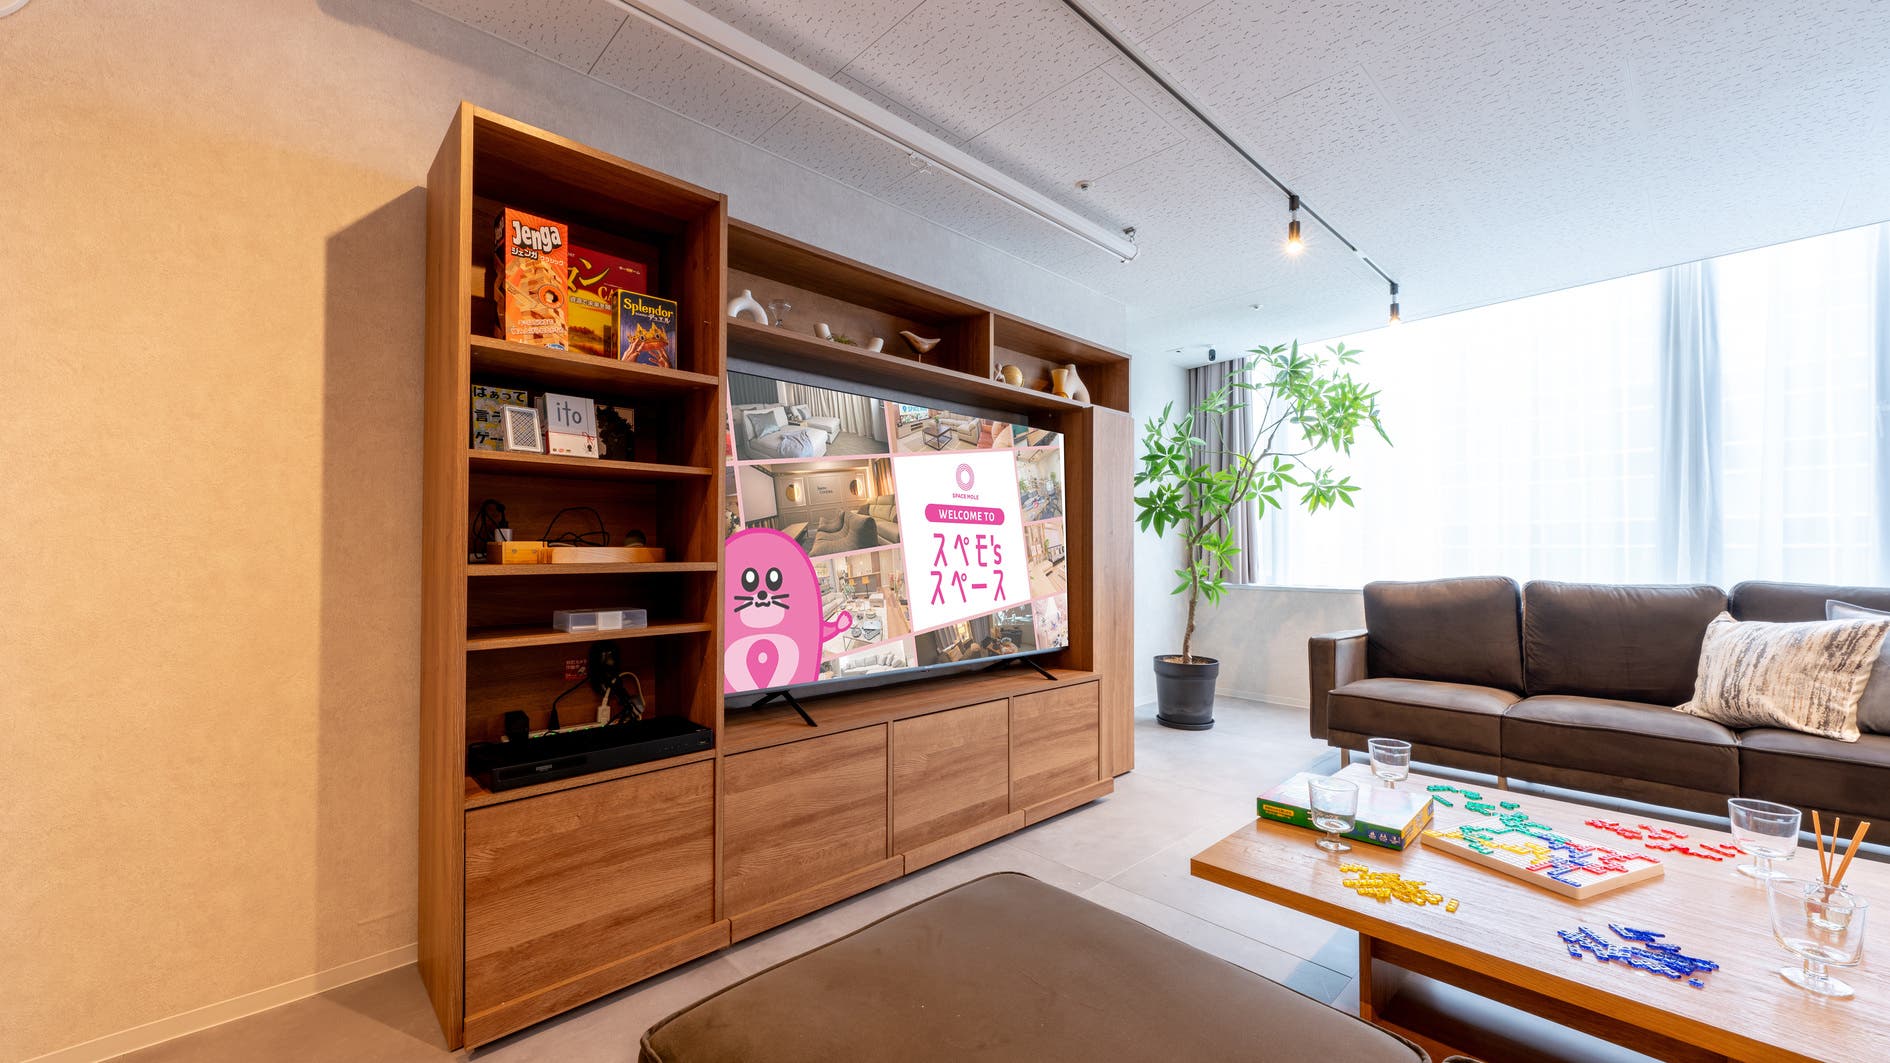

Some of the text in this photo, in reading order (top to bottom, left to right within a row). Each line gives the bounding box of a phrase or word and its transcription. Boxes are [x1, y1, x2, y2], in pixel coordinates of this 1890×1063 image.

[512, 220, 562, 252] Jenga
[511, 247, 538, 260] ジェンガ
[623, 297, 673, 318] Splendor
[473, 386, 526, 403] はぁって
[556, 400, 582, 427] ito
[938, 508, 995, 522] WELCOME TO
[933, 532, 1002, 568] スペモ's
[930, 570, 1006, 605] スペース
